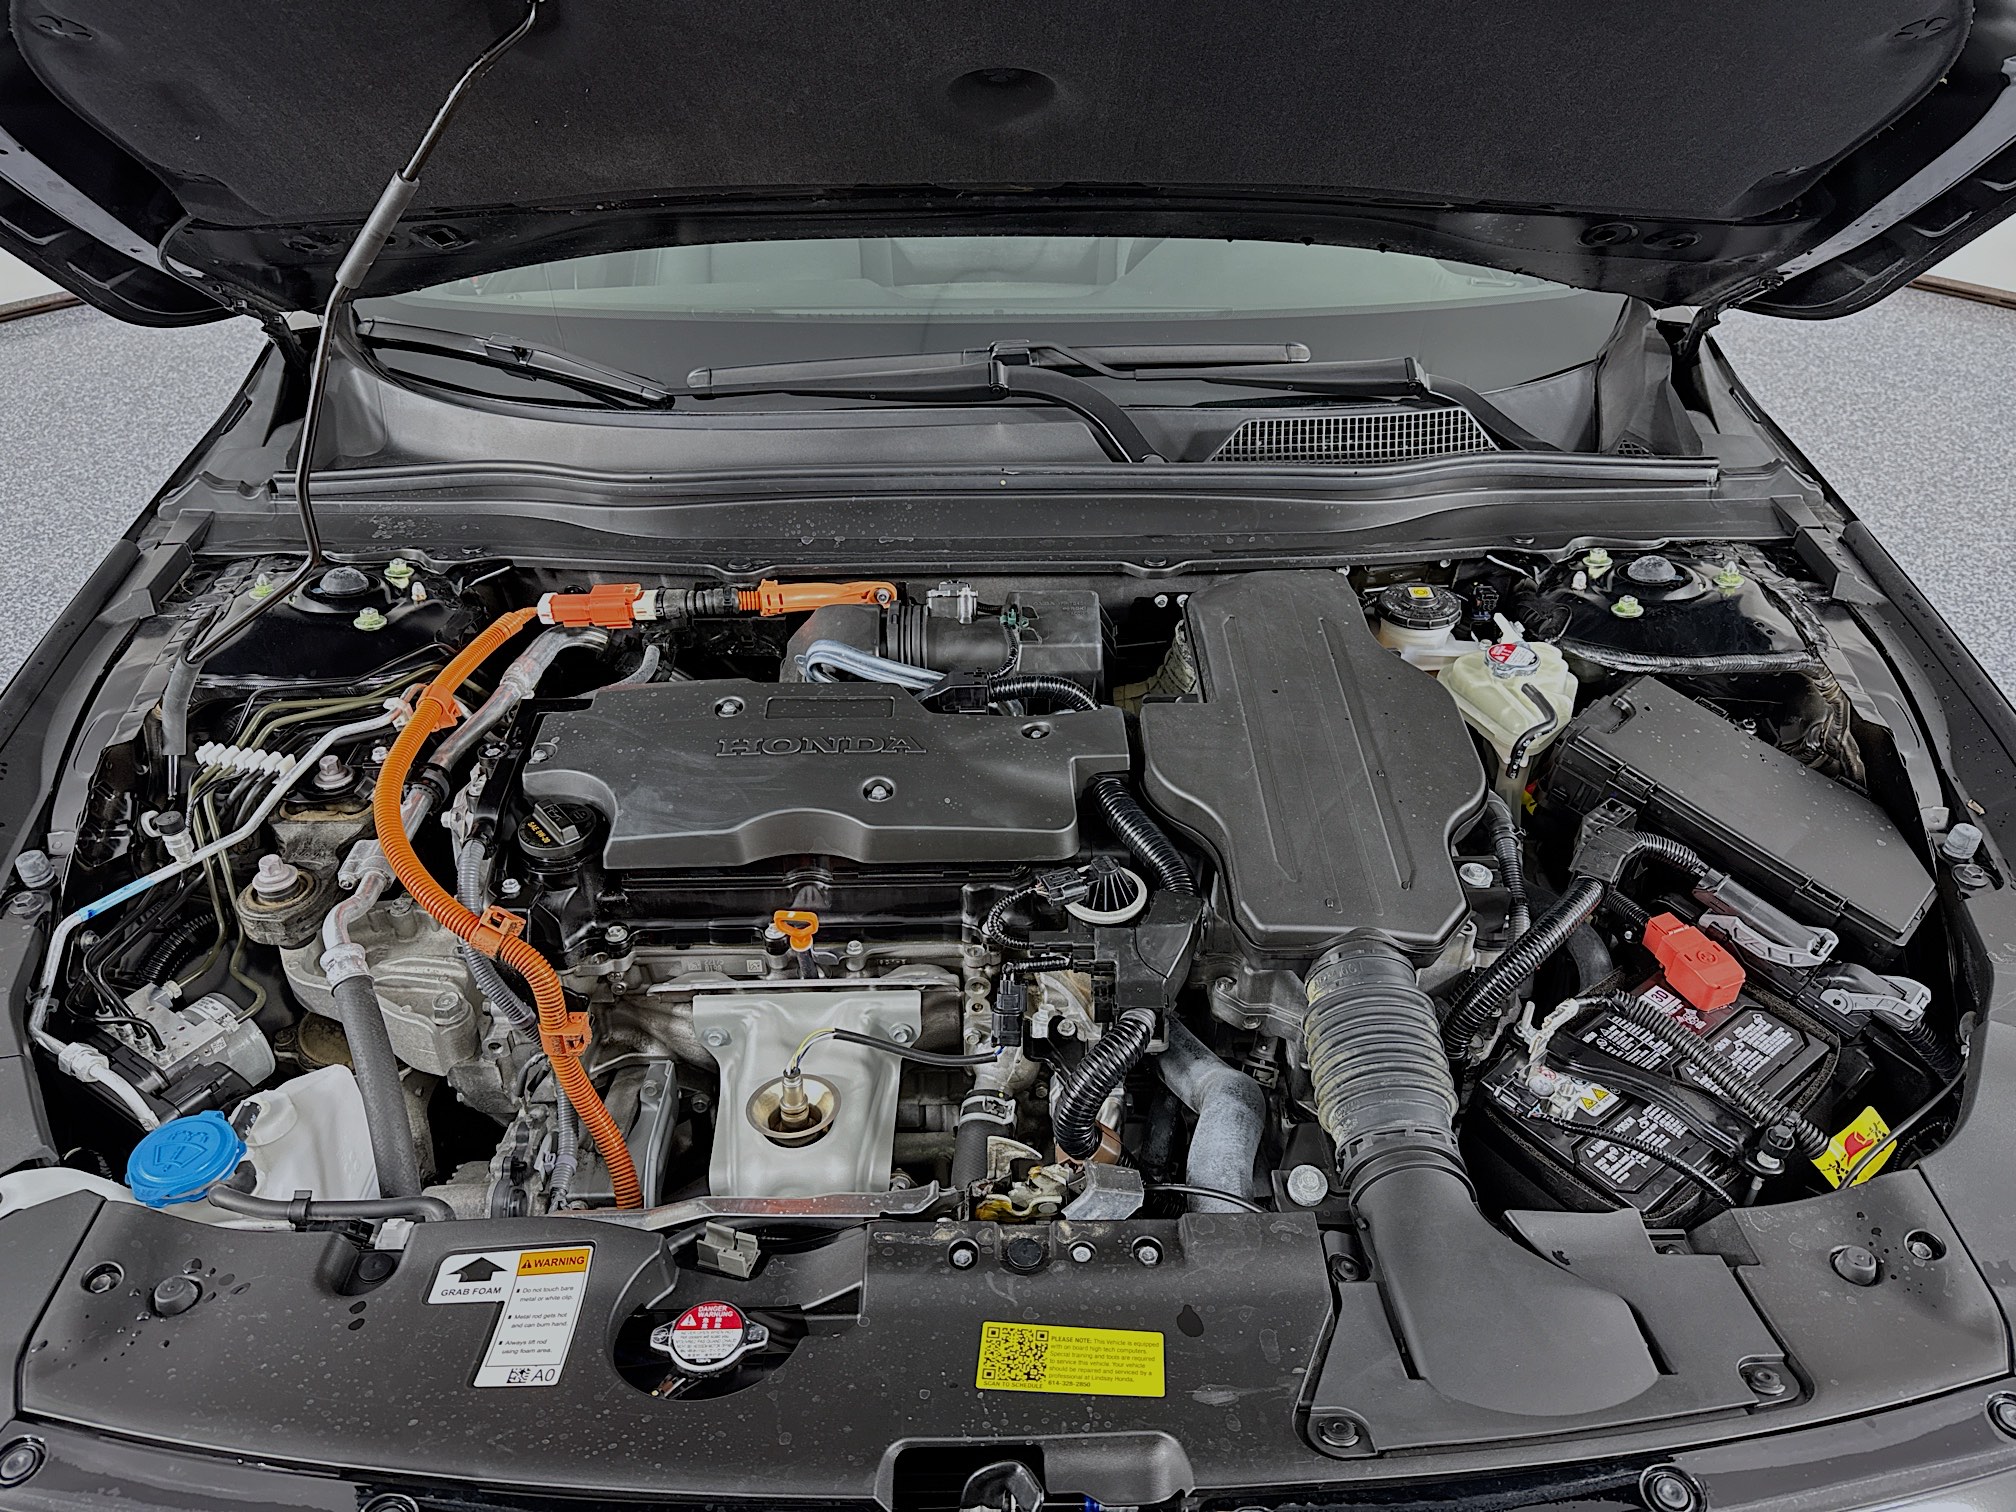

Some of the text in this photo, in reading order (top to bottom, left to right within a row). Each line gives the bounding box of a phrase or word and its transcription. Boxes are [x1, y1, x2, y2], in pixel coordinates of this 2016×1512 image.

[715, 736, 927, 757] HONDA
[527, 821, 540, 832] SAE
[534, 1256, 585, 1267] WARNING
[440, 1287, 502, 1297] GRAB FOAM
[697, 1310, 734, 1318] WARNUNG
[1051, 1335, 1074, 1343] PLEASE
[1011, 1381, 1044, 1389] SCHEDULE
